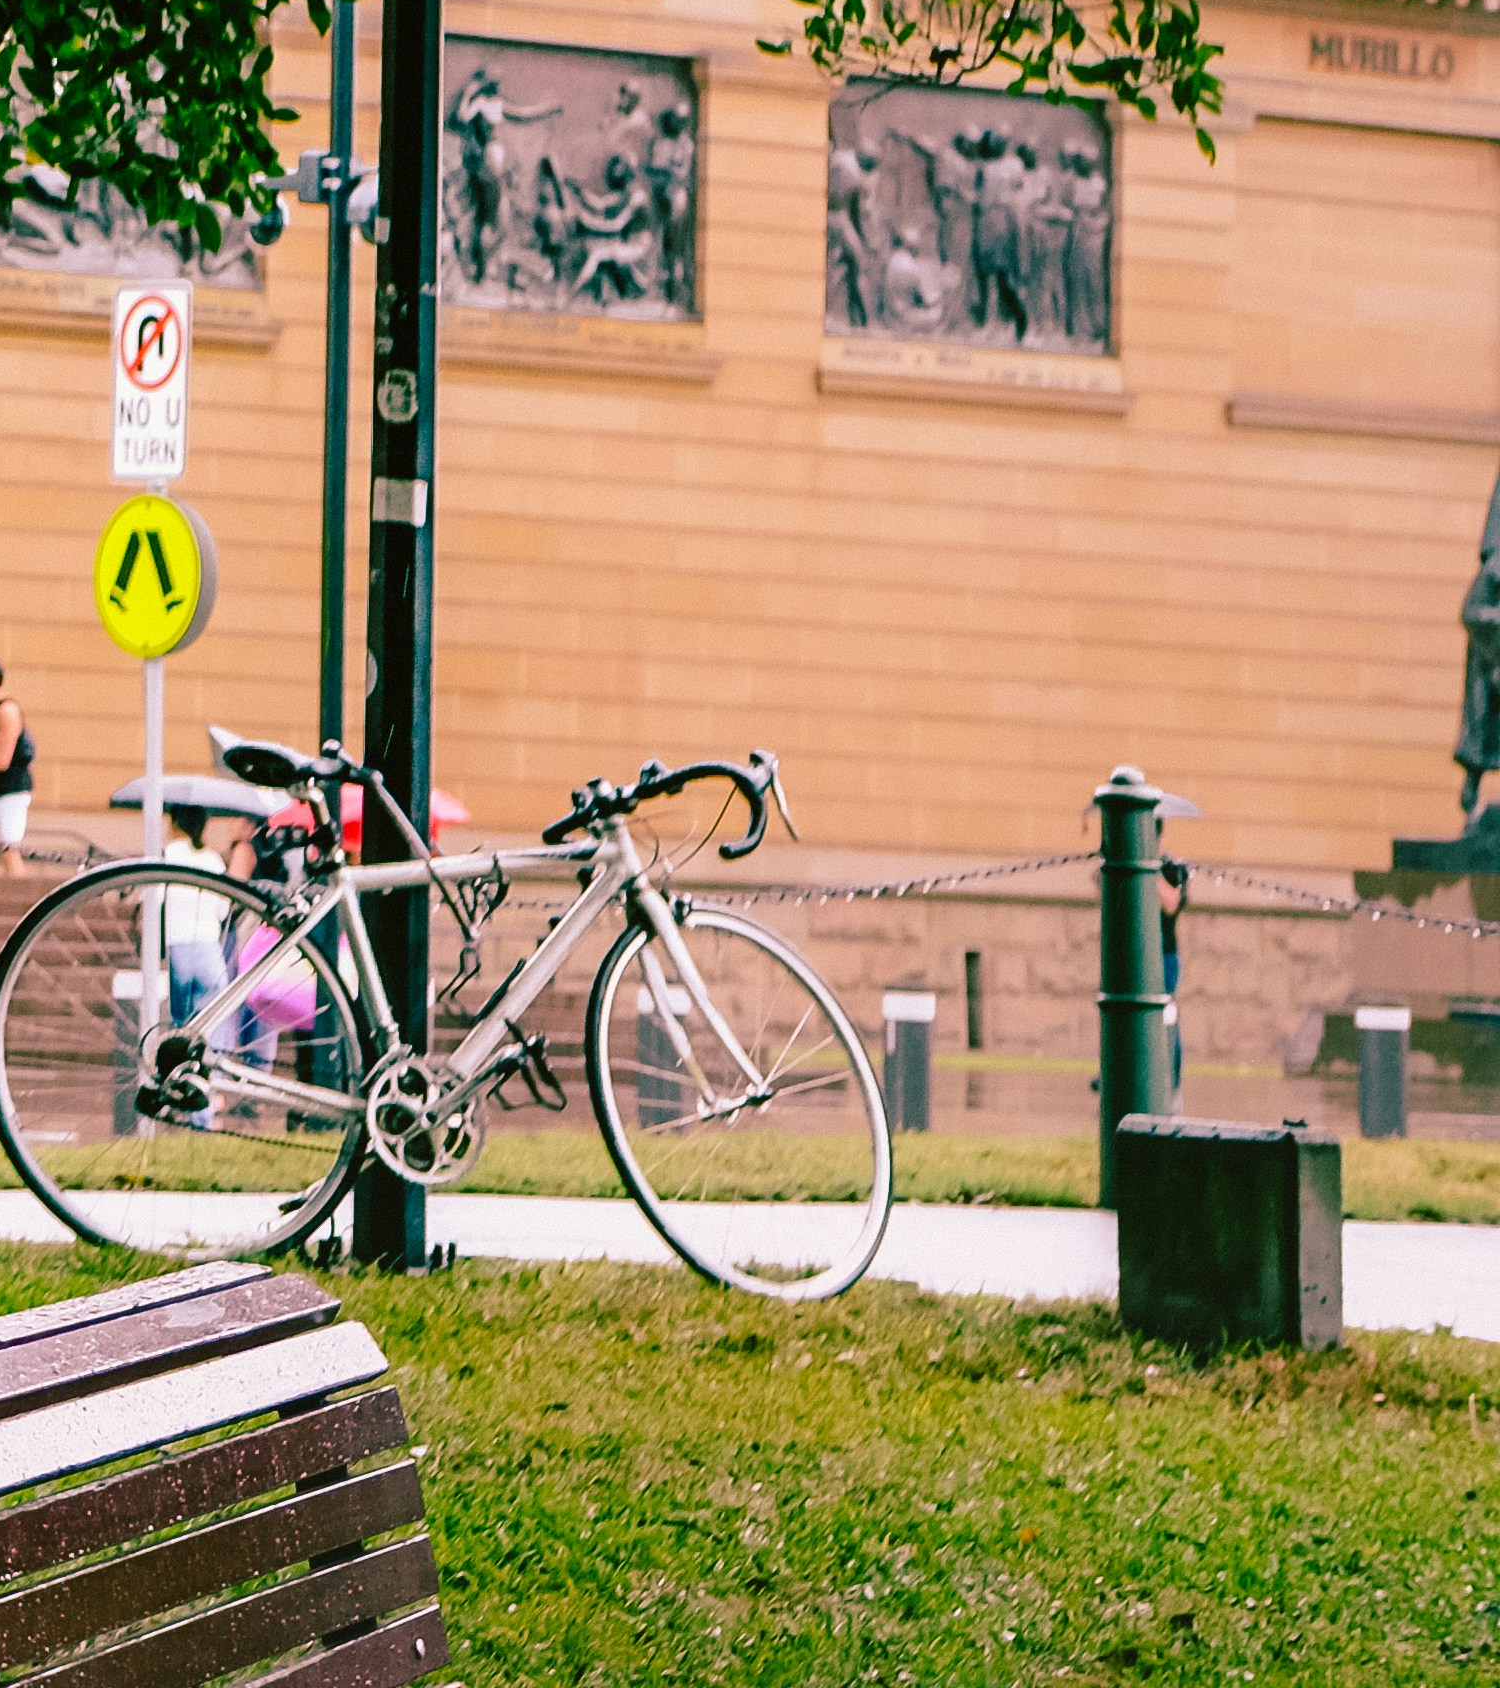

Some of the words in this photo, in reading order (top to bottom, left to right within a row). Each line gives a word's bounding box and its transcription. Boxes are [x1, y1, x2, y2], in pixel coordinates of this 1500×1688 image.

[1309, 33, 1455, 83] MURILLO
[120, 398, 150, 427] NO
[166, 398, 181, 427] U
[124, 438, 177, 465] TURN
